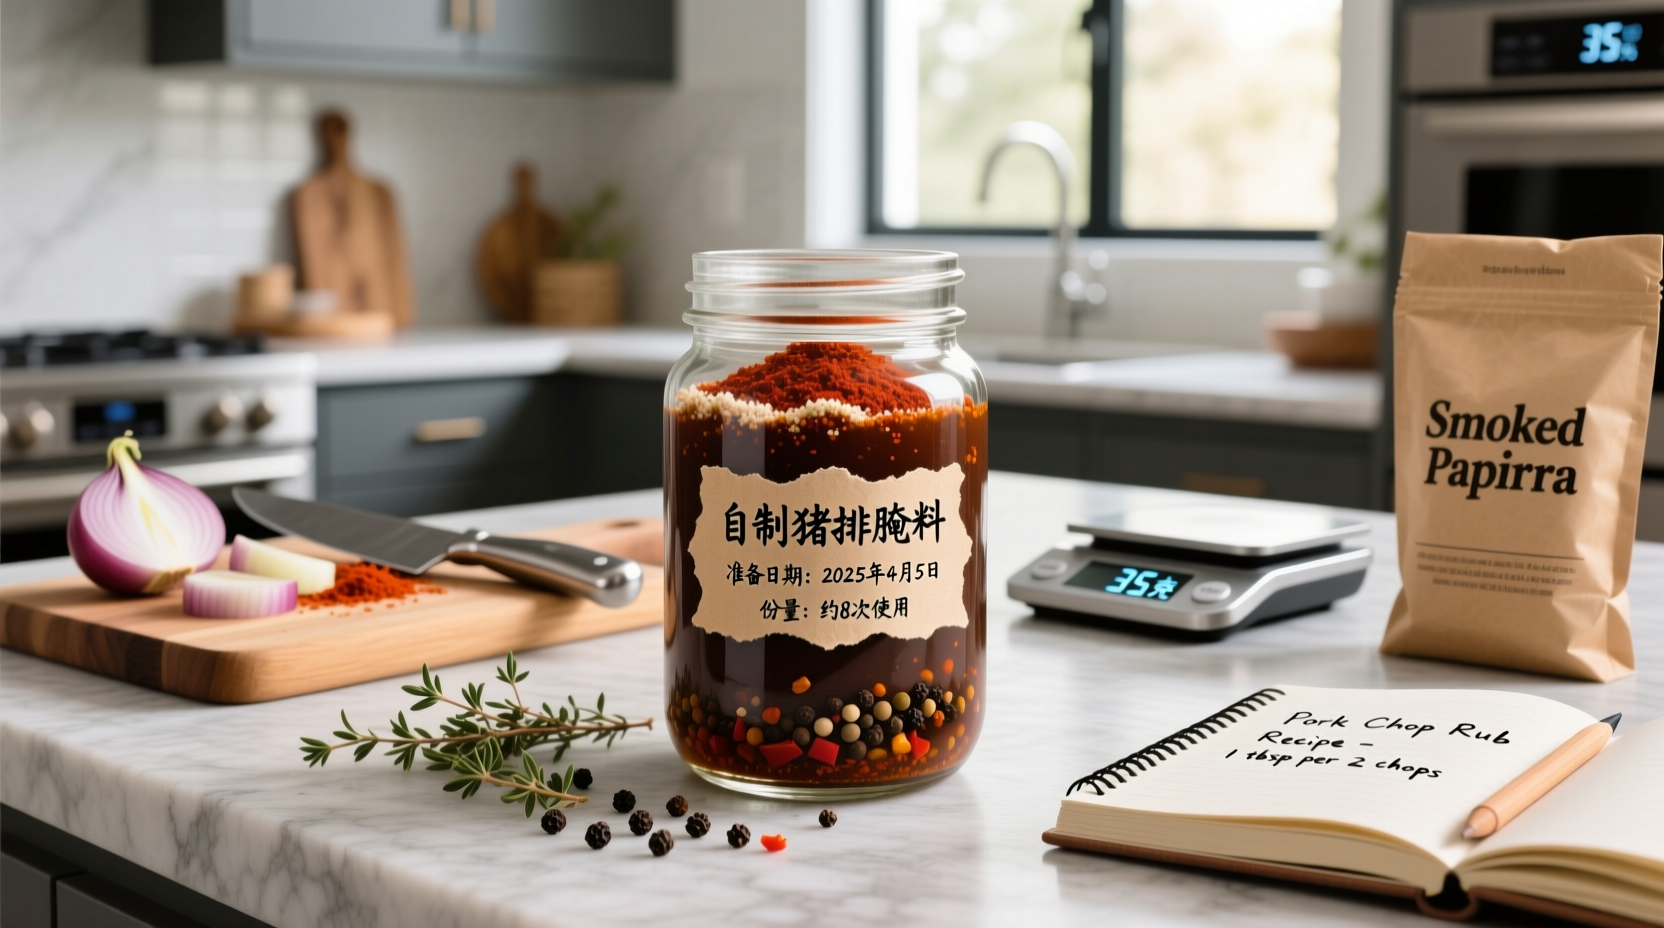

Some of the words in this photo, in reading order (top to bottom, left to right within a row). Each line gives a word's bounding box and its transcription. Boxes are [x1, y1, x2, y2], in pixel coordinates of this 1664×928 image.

[1425, 399, 1587, 447] Smoked
[1424, 446, 1578, 500] Papirra
[724, 498, 946, 548] 自制猪排腌料
[1257, 730, 1345, 752] Recipe
[1283, 711, 1349, 728] Pork
[1364, 716, 1435, 738] Chop
[1448, 722, 1510, 745] Rub
[1246, 749, 1293, 767] tbsp
[1295, 755, 1340, 768] per
[1347, 756, 1366, 768] 2
[1375, 757, 1443, 781] chops
